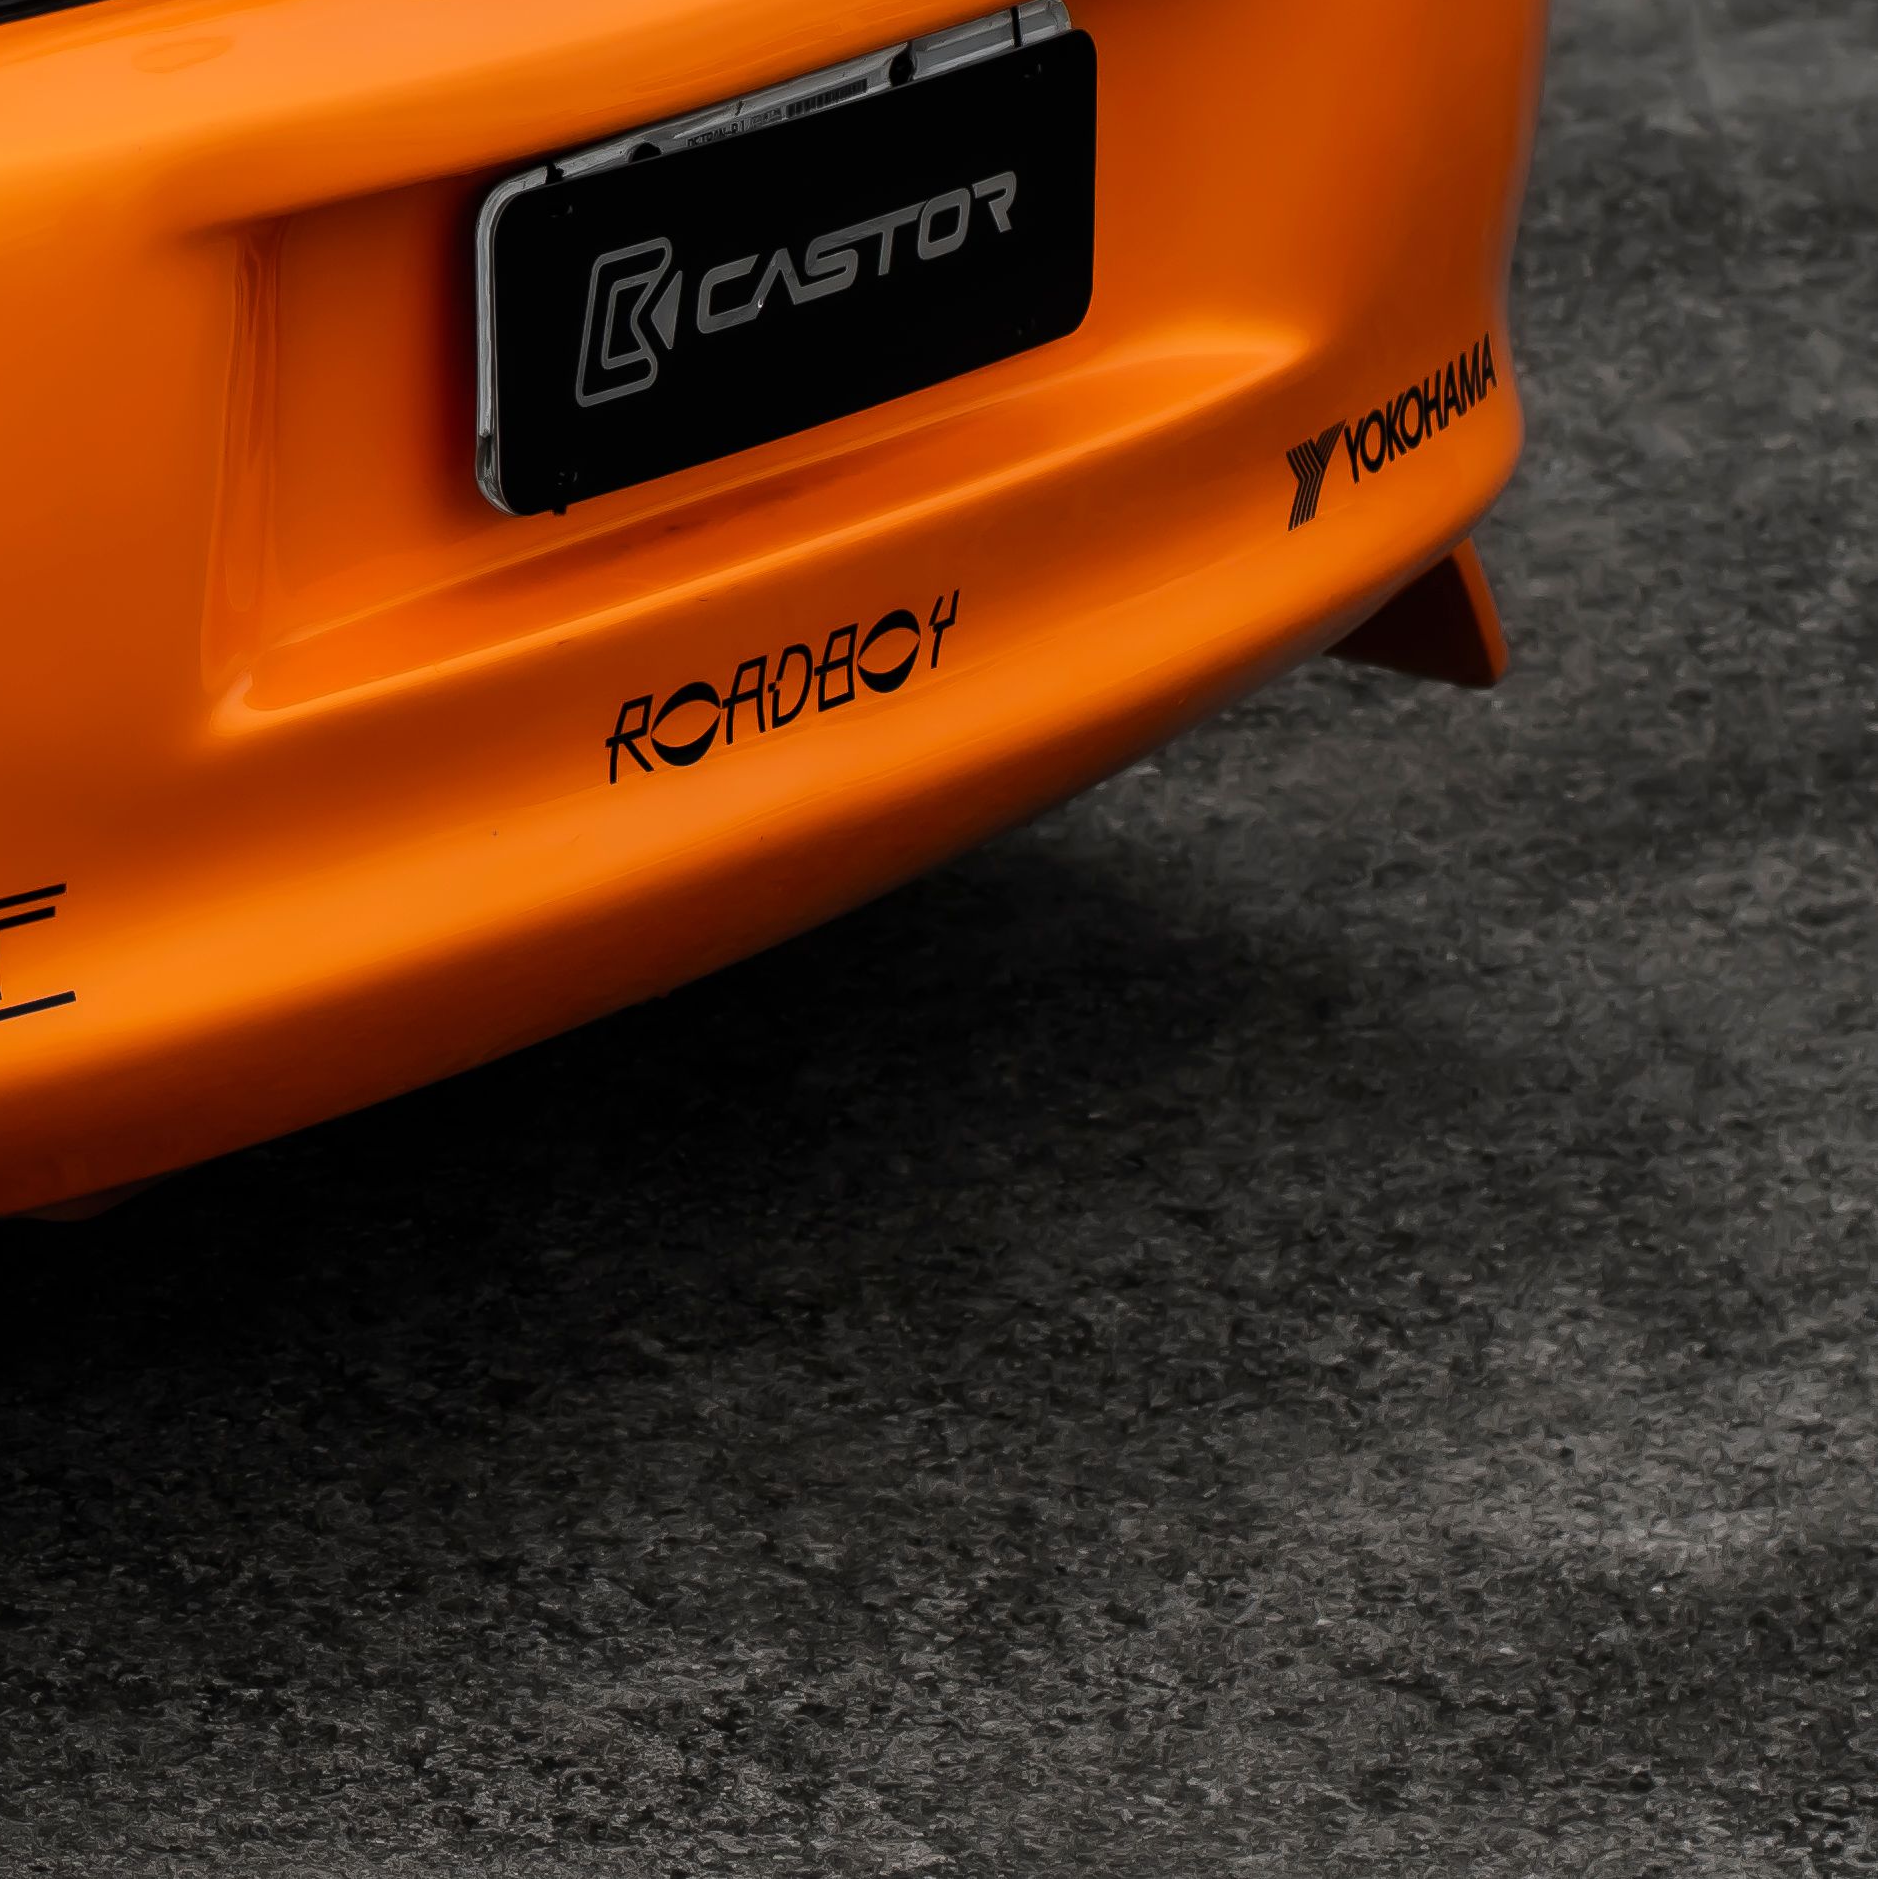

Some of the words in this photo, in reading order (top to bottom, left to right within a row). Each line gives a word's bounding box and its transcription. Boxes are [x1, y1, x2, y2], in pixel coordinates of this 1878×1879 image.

[696, 170, 1018, 335] CASTOR
[1344, 330, 1498, 485] YOKOHAMA
[604, 588, 961, 785] ROADBOY
